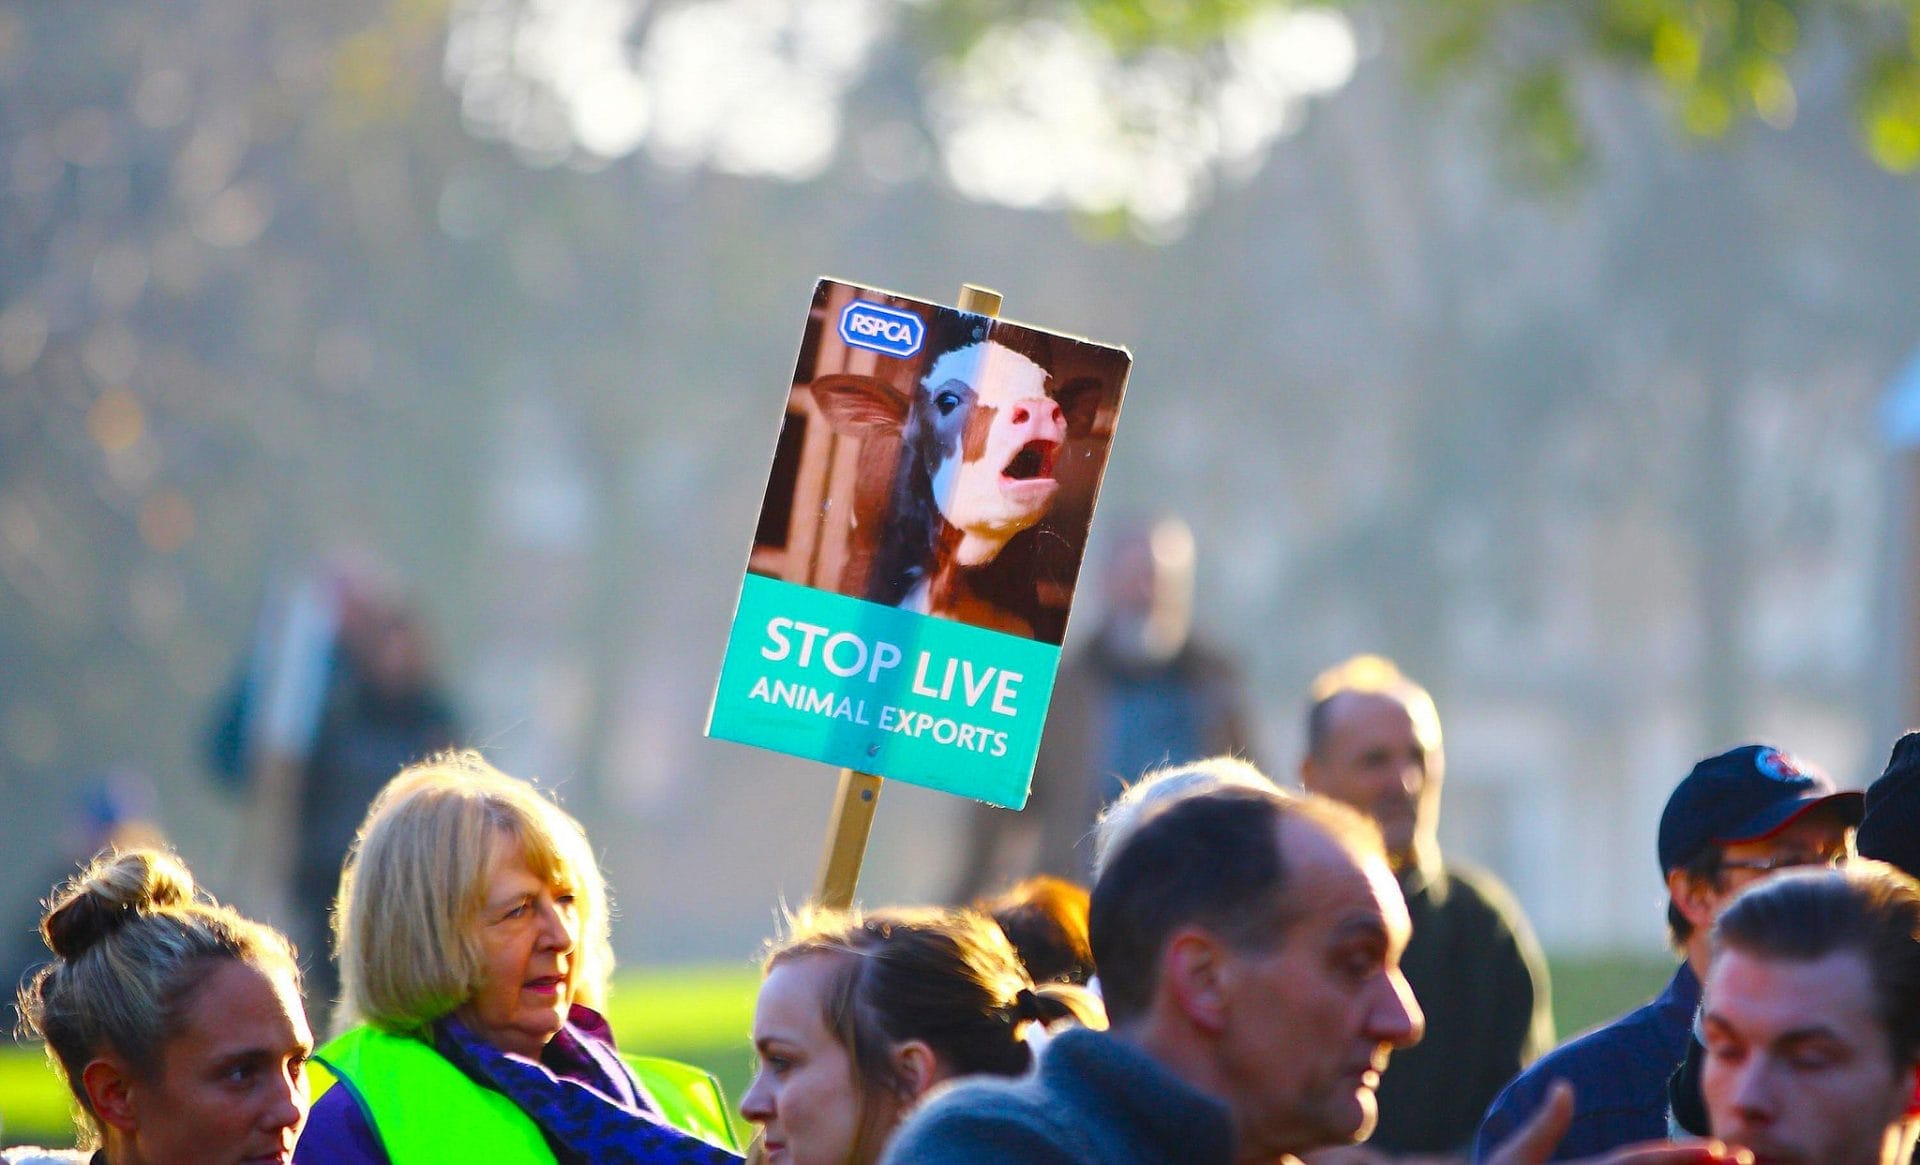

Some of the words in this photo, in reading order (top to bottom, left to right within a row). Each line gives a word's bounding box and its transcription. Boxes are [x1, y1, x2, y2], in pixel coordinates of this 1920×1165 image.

[850, 313, 912, 345] RSPCA
[761, 617, 902, 684] STOP
[912, 651, 1024, 717] LIVE
[748, 676, 871, 726] ANIMAL
[878, 706, 1009, 757] EXPORTS
